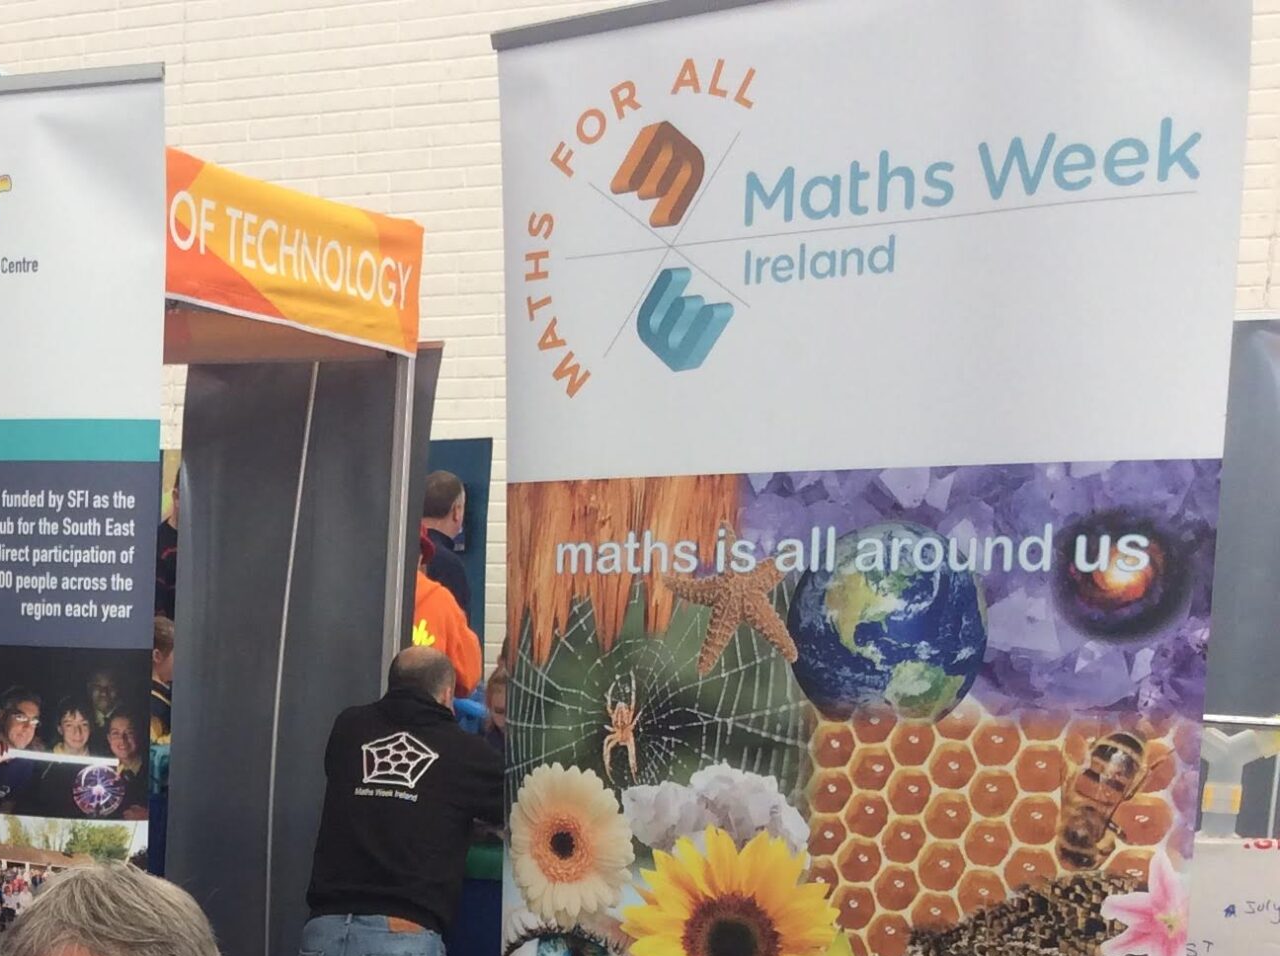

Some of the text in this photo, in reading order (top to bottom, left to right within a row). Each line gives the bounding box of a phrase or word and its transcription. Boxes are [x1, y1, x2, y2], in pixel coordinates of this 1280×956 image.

[744, 117, 1202, 227] Maths Week
[524, 58, 756, 399] MATHS FOR ALL
[170, 190, 412, 310] OF TECHNOLOGY
[744, 234, 896, 285] Ireland
[1, 256, 38, 274] Centre
[1, 490, 45, 508] funded
[48, 490, 63, 513] by
[67, 490, 89, 508] SFI
[93, 494, 109, 508] as
[113, 490, 136, 509] the
[17, 517, 36, 535] for
[38, 518, 59, 536] the
[61, 518, 101, 537] South
[105, 518, 135, 537] East
[32, 545, 116, 567] participation
[120, 546, 135, 565] of
[555, 523, 1152, 576] maths is all around us
[15, 572, 58, 594] people
[61, 575, 107, 591] across
[110, 573, 133, 592] the
[21, 600, 133, 622] region each year
